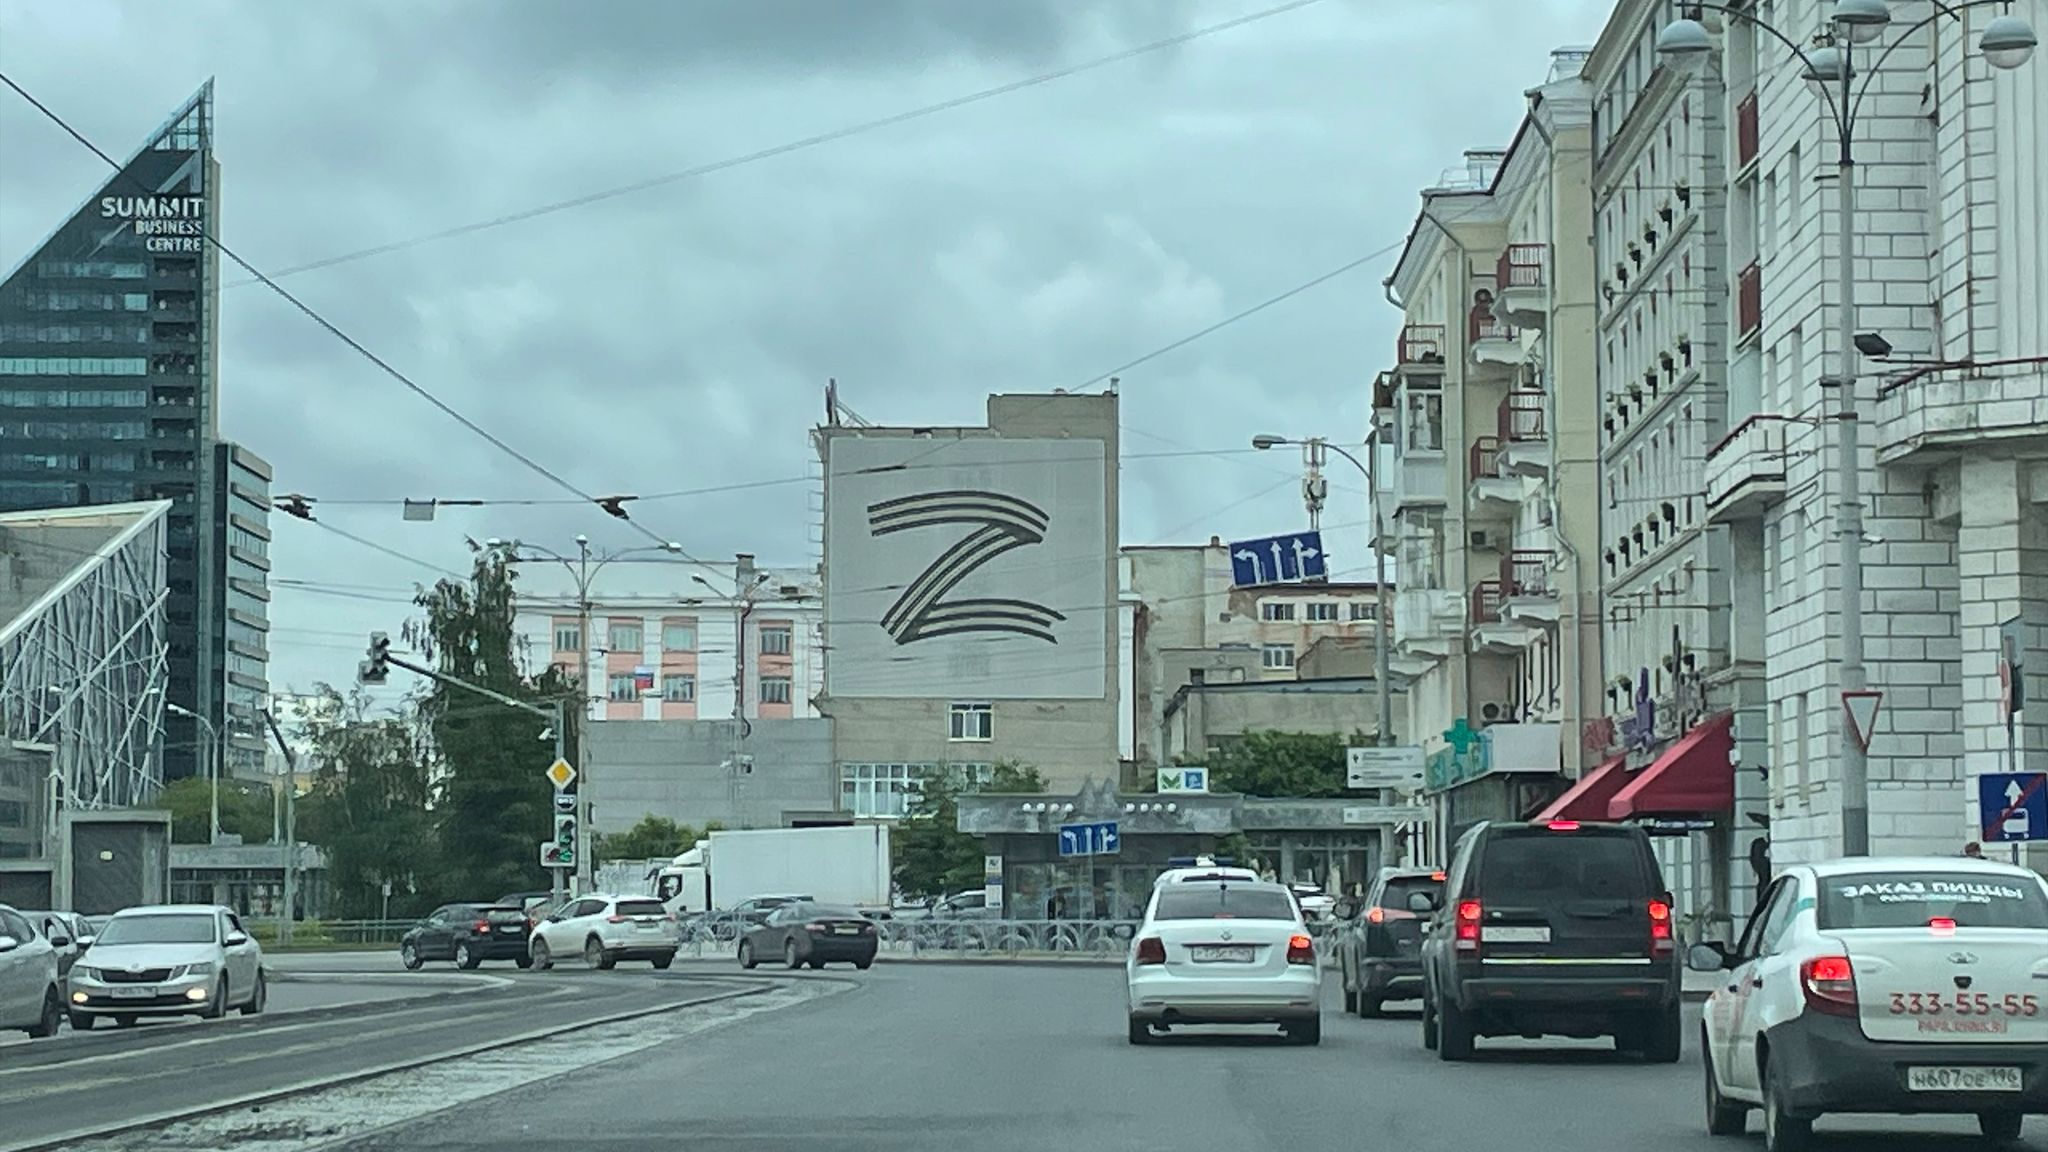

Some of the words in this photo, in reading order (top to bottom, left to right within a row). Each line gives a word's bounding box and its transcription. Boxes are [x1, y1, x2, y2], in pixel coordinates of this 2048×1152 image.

[101, 197, 204, 217] SUMMIT
[136, 220, 203, 234] BUSINESS
[146, 237, 202, 252] CENTRE
[867, 490, 1067, 645] Z
[1842, 882, 1926, 897] ЗАКАЗ
[1932, 882, 2023, 899] ПИЦЦЫ
[1889, 992, 2039, 1017] 333-55-55
